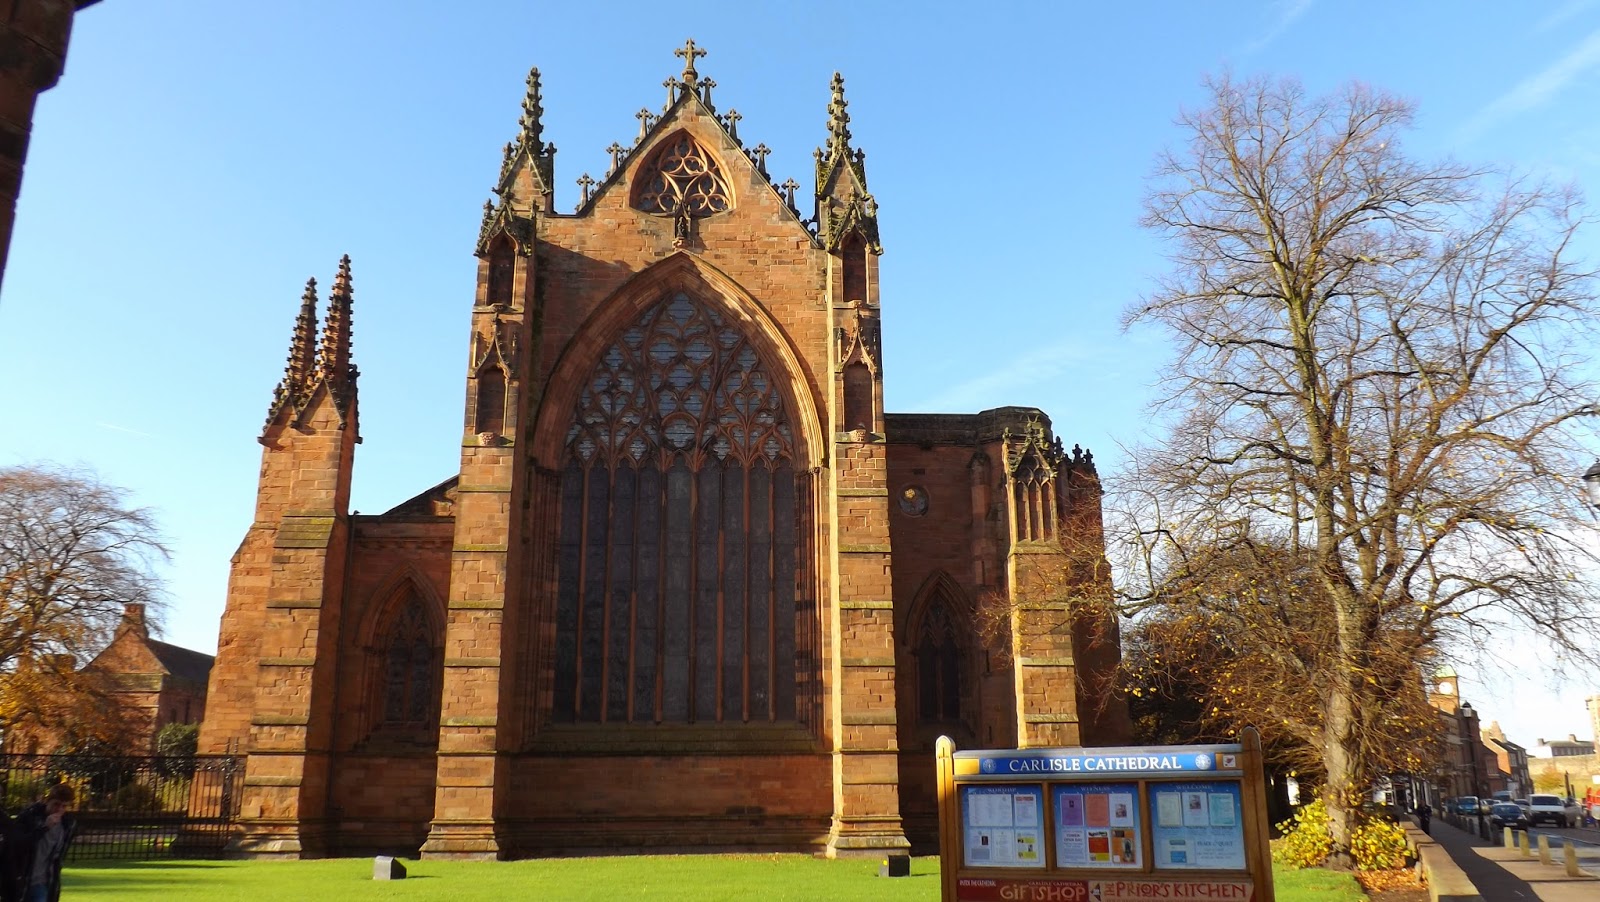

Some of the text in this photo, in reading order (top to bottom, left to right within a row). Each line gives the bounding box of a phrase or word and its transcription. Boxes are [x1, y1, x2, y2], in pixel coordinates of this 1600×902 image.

[1009, 756, 1182, 772] CARLISLE CATHEDRAL
[1173, 883, 1247, 898] KITCHEN
